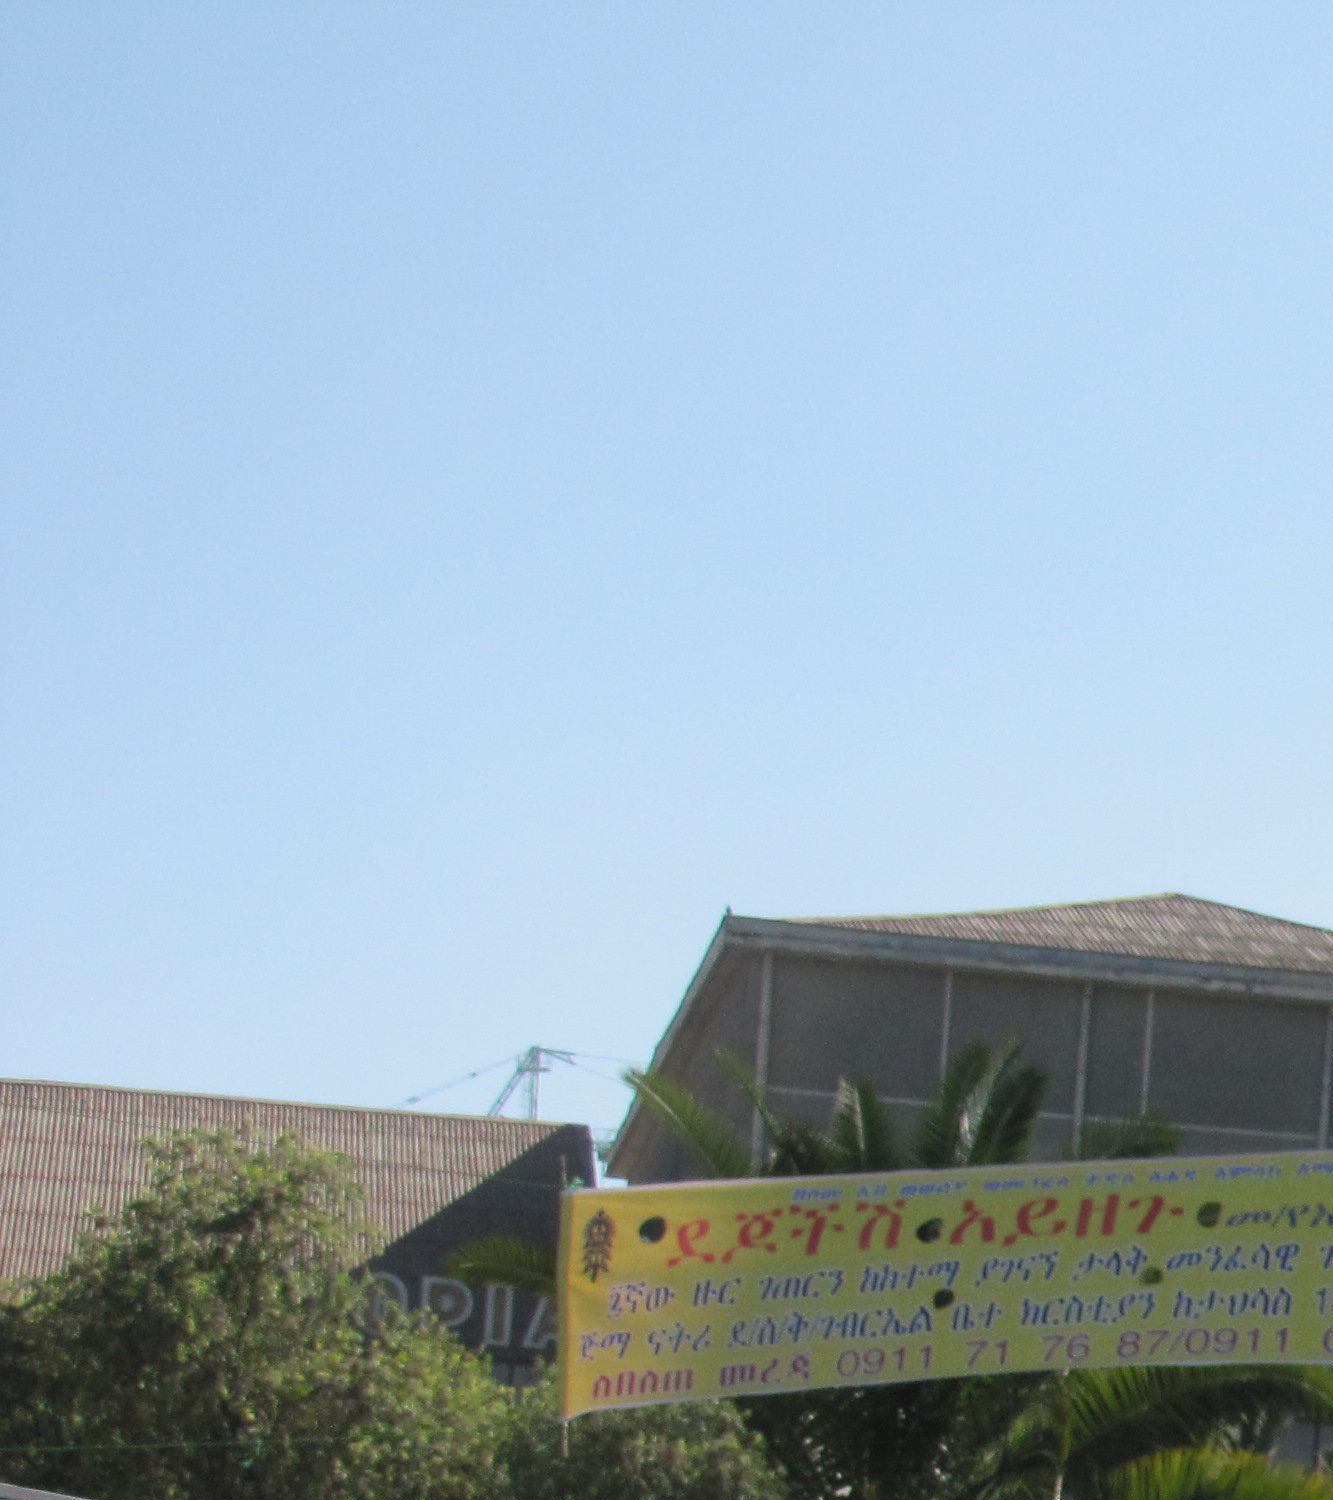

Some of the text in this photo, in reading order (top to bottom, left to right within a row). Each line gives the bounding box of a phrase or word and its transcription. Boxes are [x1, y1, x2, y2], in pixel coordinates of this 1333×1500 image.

[950, 1193, 1185, 1247] አይዘጉ
[692, 1277, 742, 1308] ዙር
[859, 1260, 961, 1294] ከከተማ
[1072, 1244, 1150, 1282] ታላቅ
[1166, 1240, 1301, 1272] መንፈሳዊ
[951, 1300, 1004, 1331] ቤተ
[1021, 1289, 1156, 1327] ክርስቲያን
[592, 1368, 695, 1399] ለበለጠ
[719, 1353, 811, 1388] መረጃ
[835, 1344, 933, 1378] 0911
[965, 1338, 1010, 1368] 71
[1041, 1332, 1092, 1362] 76
[1115, 1326, 1290, 1359] 87/0911
